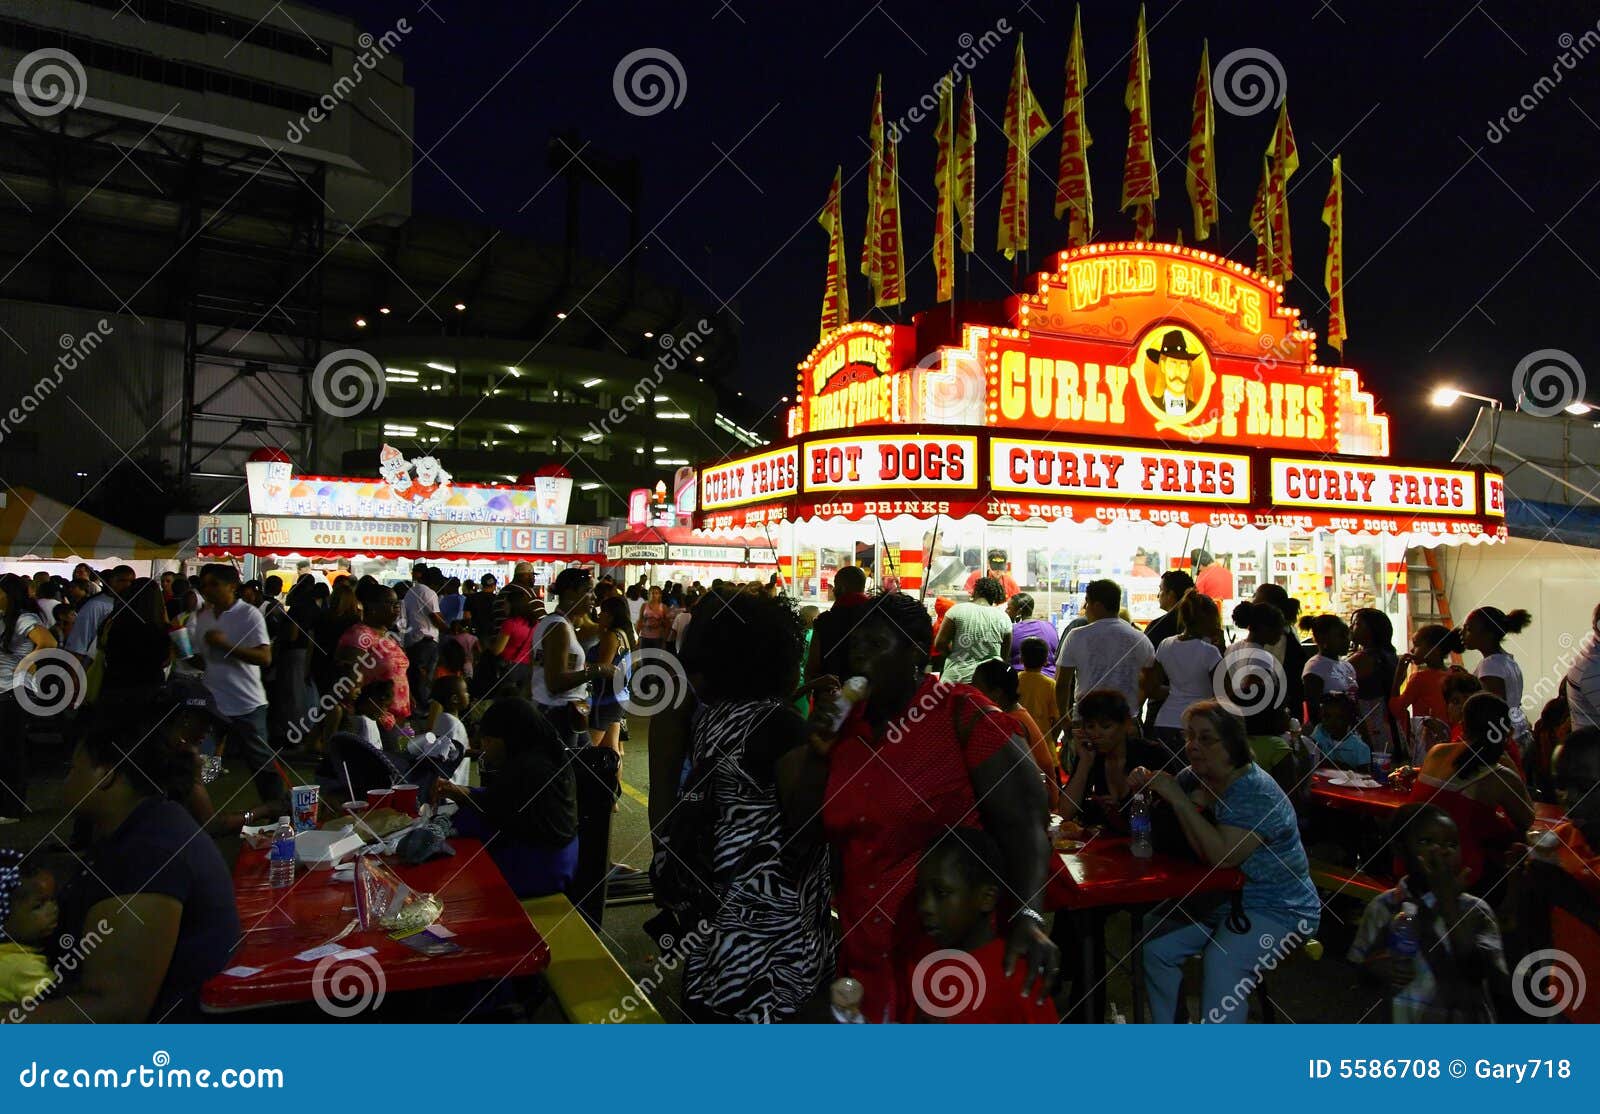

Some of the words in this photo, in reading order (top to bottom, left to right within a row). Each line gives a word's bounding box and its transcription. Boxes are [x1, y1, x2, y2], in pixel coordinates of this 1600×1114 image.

[1070, 257, 1157, 311] WILD
[1170, 262, 1263, 335] BILL'S
[812, 343, 846, 395] WILD
[847, 374, 890, 428] FRIES
[1001, 350, 1129, 424] CURLY
[1221, 373, 1326, 440] FRIES
[705, 466, 745, 503] CURLY
[751, 454, 795, 494] FRIES
[811, 444, 863, 484] HOT
[878, 442, 965, 482] DOGS
[1009, 447, 1124, 489] CURLY
[1141, 456, 1235, 495] FRIES
[1286, 466, 1376, 502] CURLY
[1389, 473, 1464, 507] FRIES
[256, 518, 279, 533] TOO
[768, 507, 788, 521] DOGS
[814, 502, 854, 515] COLD
[864, 501, 950, 514] DRINKS
[987, 502, 1020, 515] HOT
[1029, 504, 1074, 518] DOGS
[1096, 507, 1142, 521] CORN
[1149, 509, 1190, 523] DOGS
[1209, 512, 1248, 526] COLD
[1254, 514, 1313, 528] DRINKS
[1330, 517, 1358, 530] HOT
[1363, 519, 1398, 532] DOGS
[1412, 521, 1448, 534] CORN
[1451, 522, 1484, 534] DOGS
[202, 527, 242, 545] ICEE
[310, 520, 343, 532] BLUE
[345, 521, 418, 533] RASPBERRY
[314, 534, 346, 545] COLA
[362, 535, 412, 547] CHERRY
[498, 528, 567, 550] ICEE
